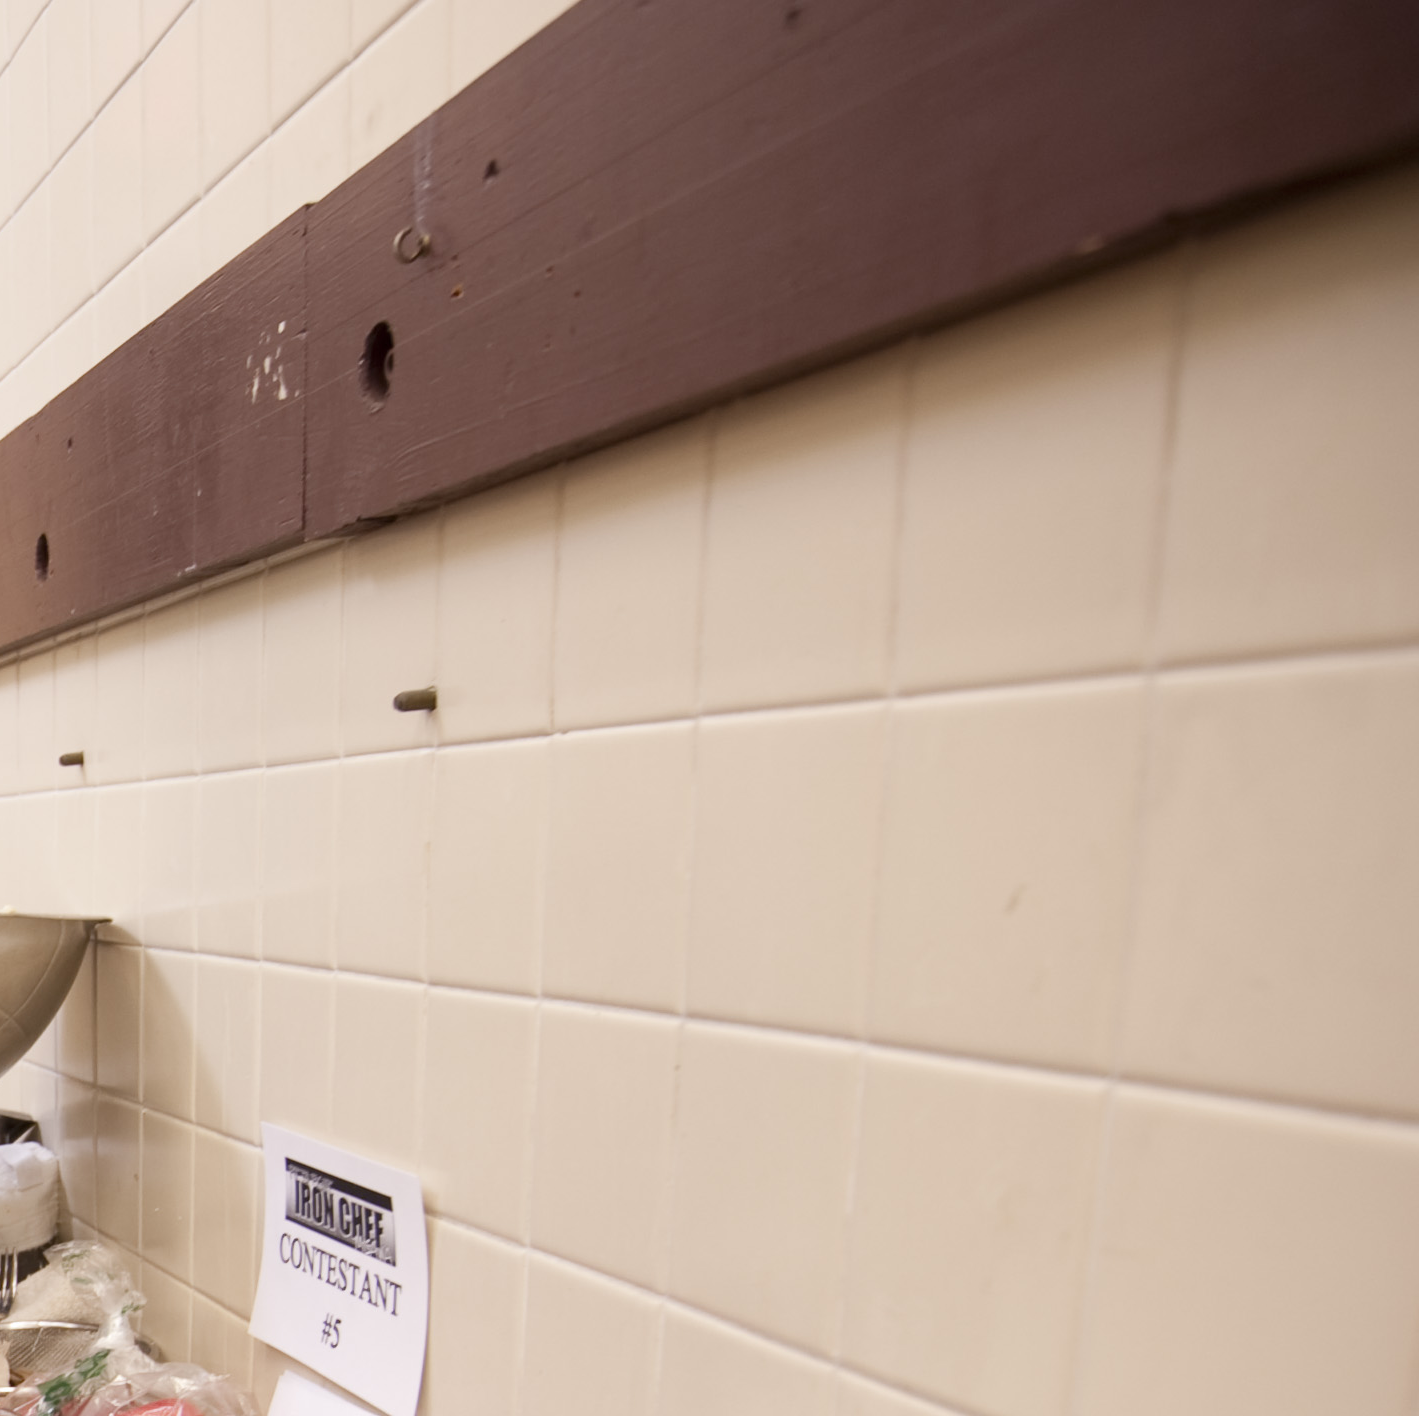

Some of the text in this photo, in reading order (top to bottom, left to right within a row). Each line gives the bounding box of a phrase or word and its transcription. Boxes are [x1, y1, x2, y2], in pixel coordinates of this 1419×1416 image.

[294, 1179, 384, 1248] IRON CHEF
[279, 1232, 402, 1317] CONTESTANT
[321, 1312, 342, 1348] #5
